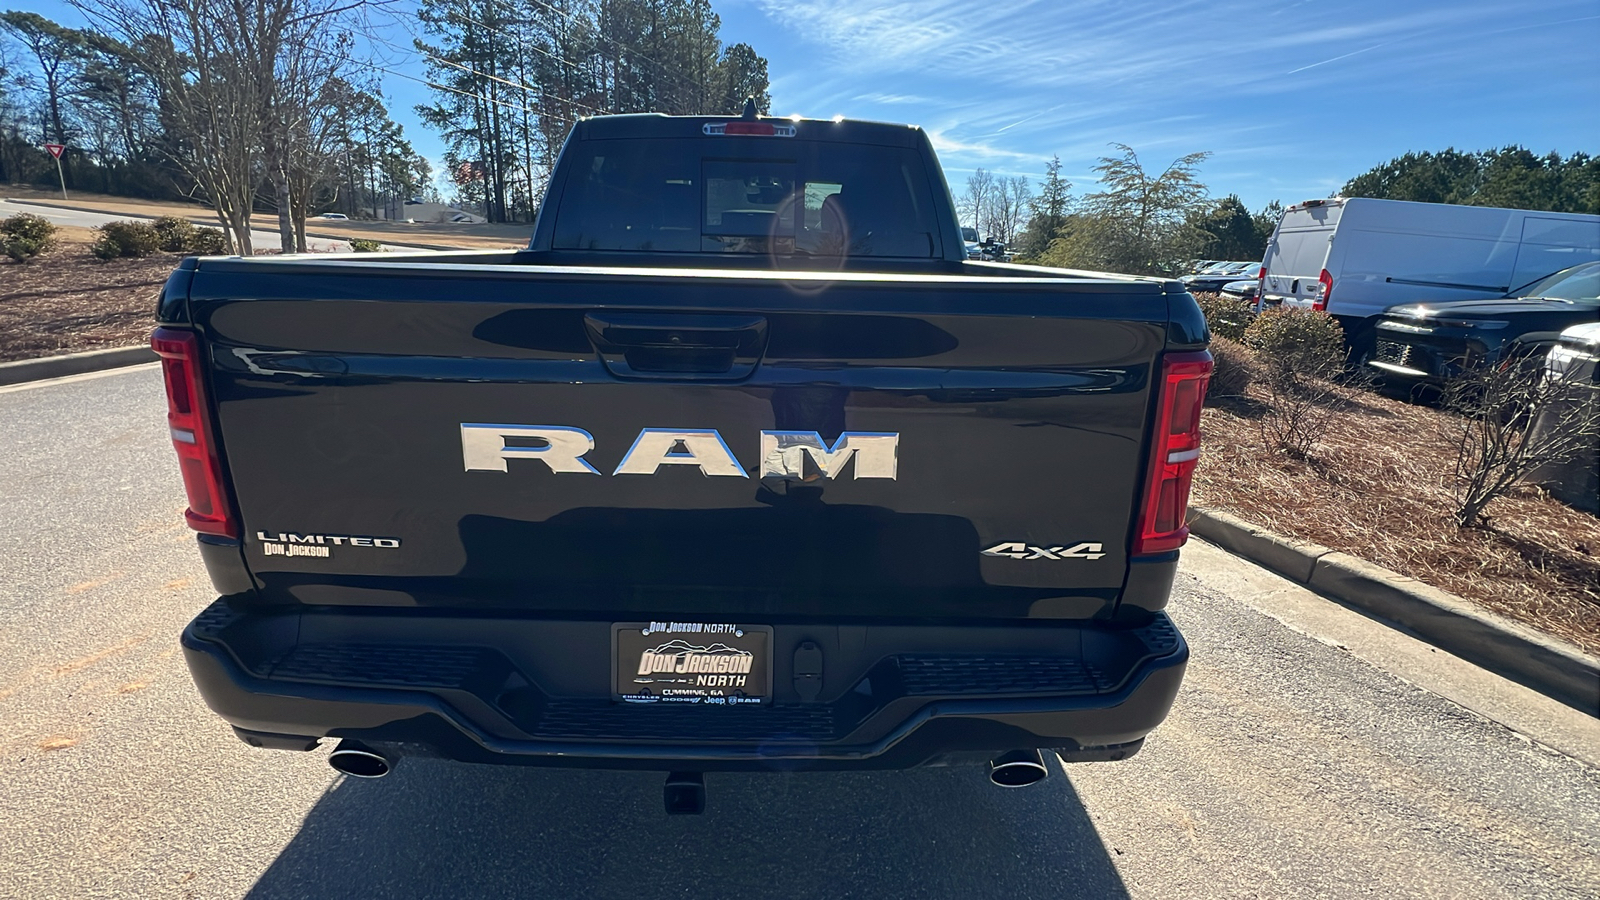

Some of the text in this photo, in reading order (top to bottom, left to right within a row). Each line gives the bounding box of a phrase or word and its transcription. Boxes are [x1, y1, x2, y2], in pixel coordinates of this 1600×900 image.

[460, 422, 899, 480] RAM
[256, 530, 401, 549] LIMITED
[263, 542, 330, 558] DON JACKSON
[649, 621, 736, 634] DON JACKSON NORTH
[637, 652, 754, 675] DON JACKSON
[696, 675, 747, 687] NORTH
[704, 696, 726, 705] Jeep
